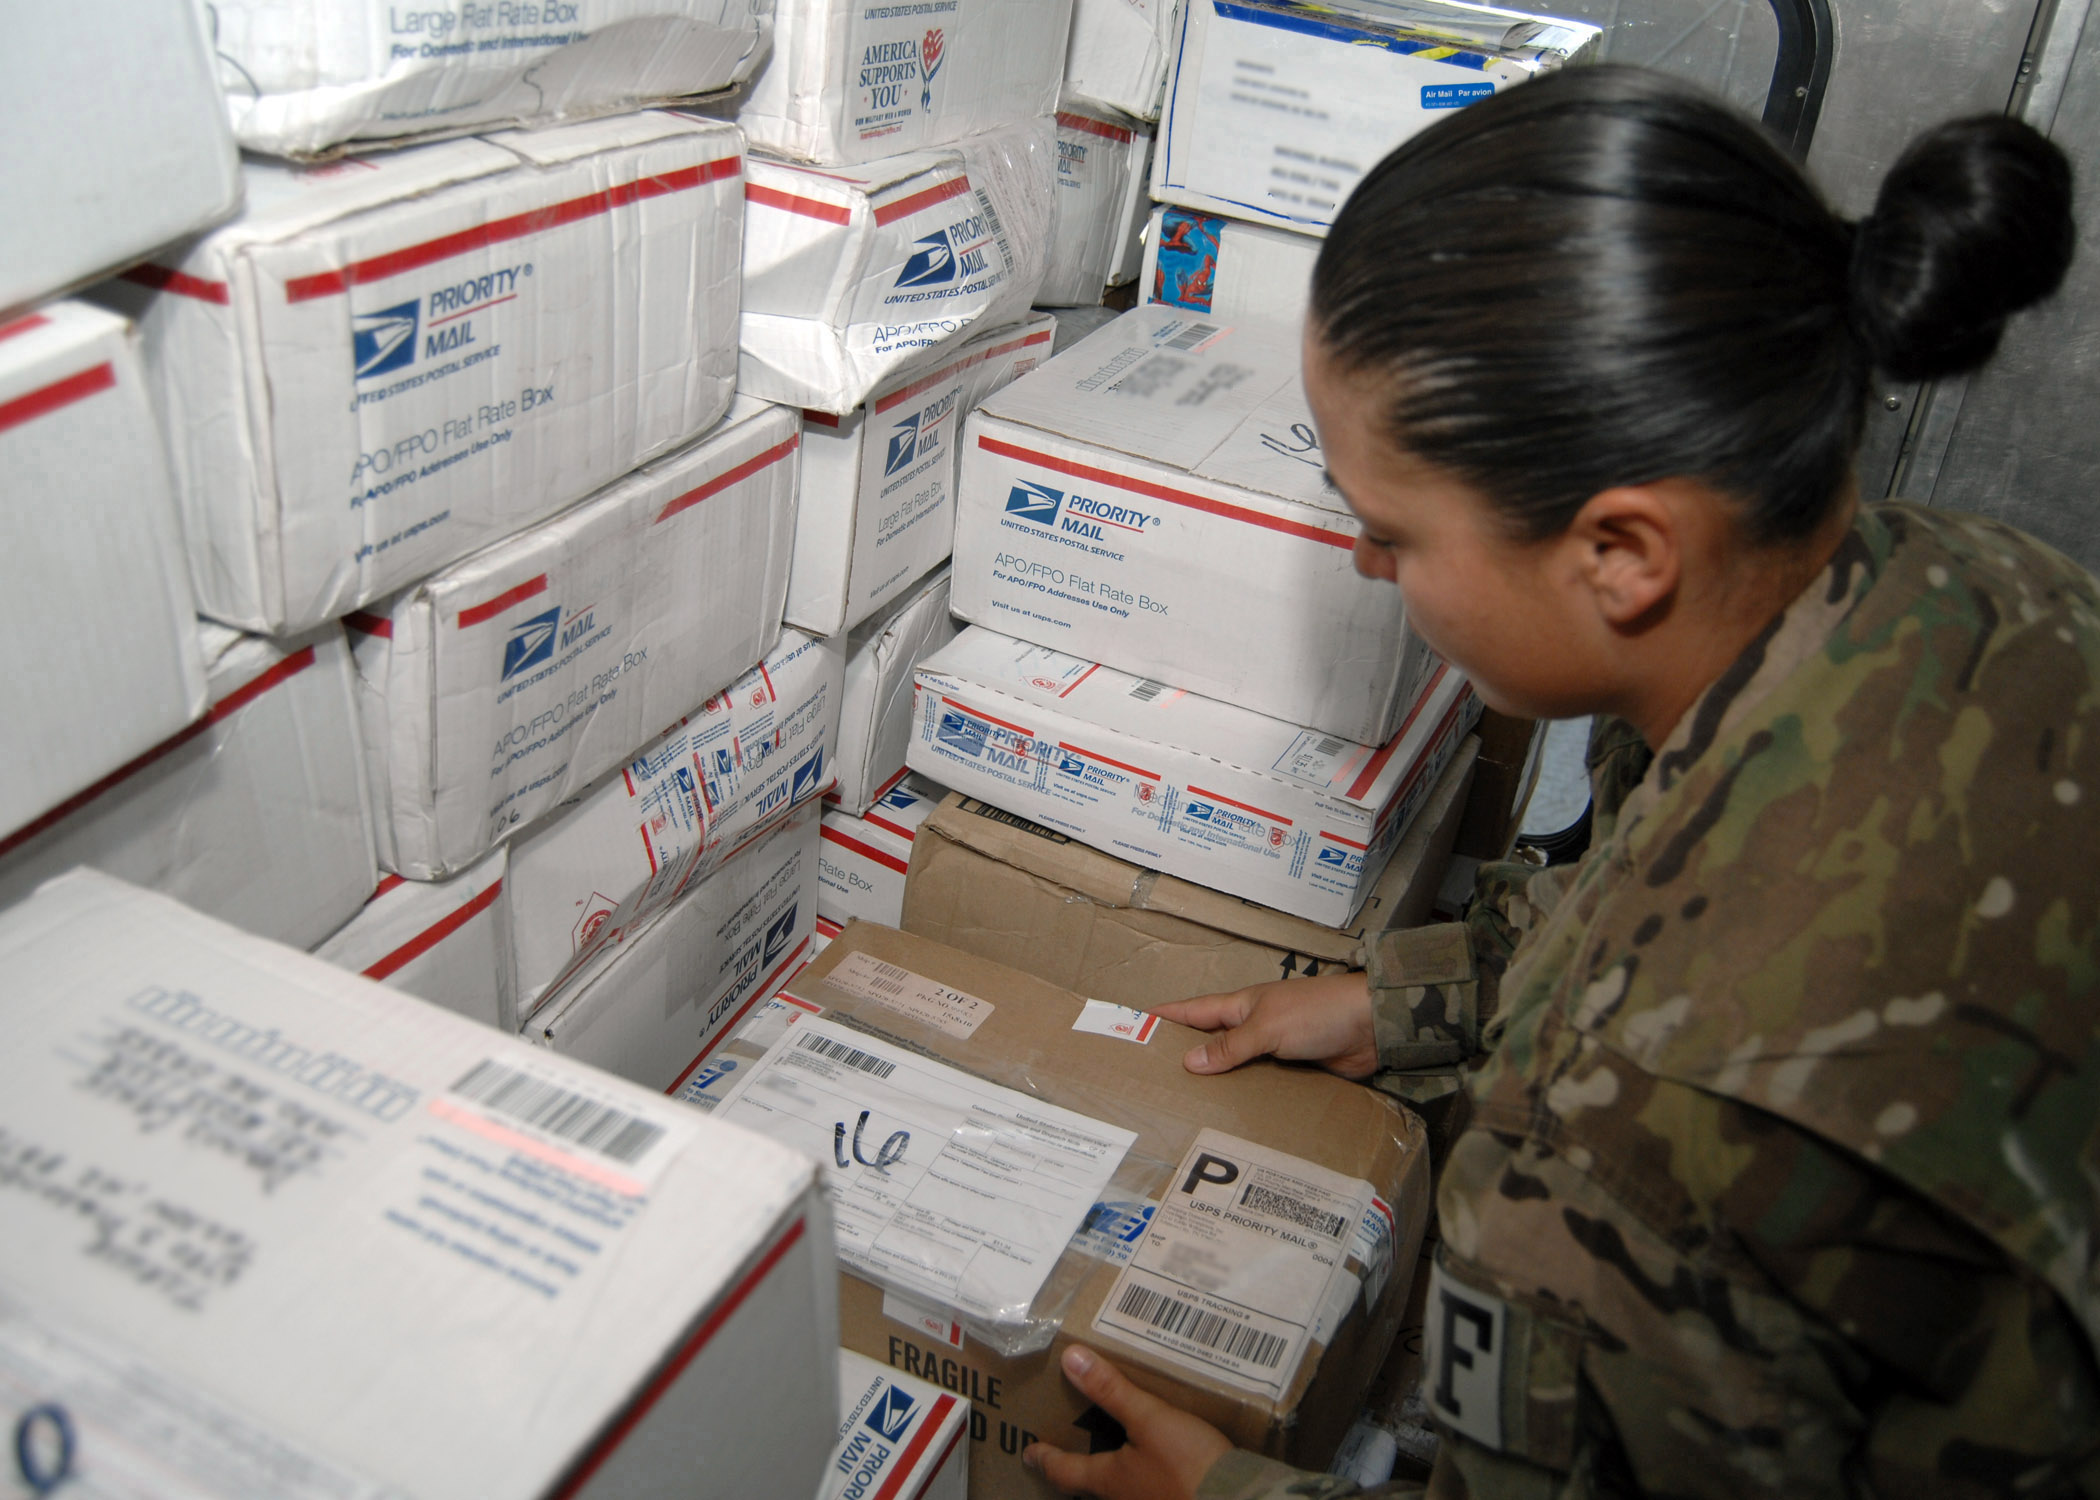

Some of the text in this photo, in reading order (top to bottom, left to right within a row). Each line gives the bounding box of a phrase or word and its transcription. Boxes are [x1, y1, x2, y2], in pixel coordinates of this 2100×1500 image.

[389, 6, 457, 39] Large
[541, 0, 579, 24] Box
[391, 43, 418, 59] For
[862, 40, 917, 65] AMERICA
[859, 61, 916, 87] SUPPORTS
[871, 84, 902, 109] YOU
[1437, 90, 1453, 98] Mail
[1458, 89, 1470, 97] Par
[1471, 88, 1492, 97] avion
[959, 248, 989, 279] MAIL
[884, 280, 989, 305] UNITED STATES POSTAL
[425, 320, 476, 359] MAIL
[875, 345, 893, 354] For
[387, 344, 502, 398] STATES POSTAL SERVICE
[349, 385, 555, 488] APO/FPO Flat Rate Box
[917, 430, 940, 459] MAIL
[366, 470, 417, 499] APO/FPO
[490, 428, 513, 445] Only
[1000, 518, 1125, 562] UNITED STATES POSTAL SERVICE
[1061, 517, 1105, 542] MAIL
[993, 570, 1130, 618] For APO/FPO Addresses Use Only
[995, 551, 1170, 616] APO/FPO Flat Rate Box
[560, 611, 596, 651] MAIL
[992, 600, 1072, 629] Visit us at usps.com
[493, 703, 564, 760] APO/FPO
[592, 663, 620, 695] Rate
[623, 647, 648, 673] Box
[963, 728, 983, 741] MAIL
[931, 744, 961, 764] UNITED
[959, 755, 986, 774] STATES
[986, 768, 1017, 785] POSTAL
[1017, 777, 1052, 796] SERVICE
[986, 748, 1030, 775] MAIL
[1083, 773, 1105, 786] MAIL
[755, 778, 789, 818] MAIL
[1131, 806, 1147, 817] For
[1263, 849, 1281, 859] Use
[1212, 817, 1234, 830] MAIL
[818, 857, 873, 893] Rate Box
[836, 885, 849, 894] Use
[733, 938, 762, 977] MAIL
[935, 988, 979, 1009] 2 OF 2
[1016, 1113, 1038, 1125] United
[834, 1110, 911, 1176] 16
[1181, 1152, 1239, 1195] P
[1189, 1200, 1221, 1217] USPS
[1223, 1213, 1279, 1236] PRIORITY
[1312, 1254, 1334, 1267] 0004
[1177, 1289, 1199, 1302] USPS
[1201, 1298, 1244, 1318] TRACKING
[1435, 1287, 1494, 1417] F
[889, 1335, 1003, 1410] FRAGILE
[840, 1375, 885, 1435] UNITED STATES
